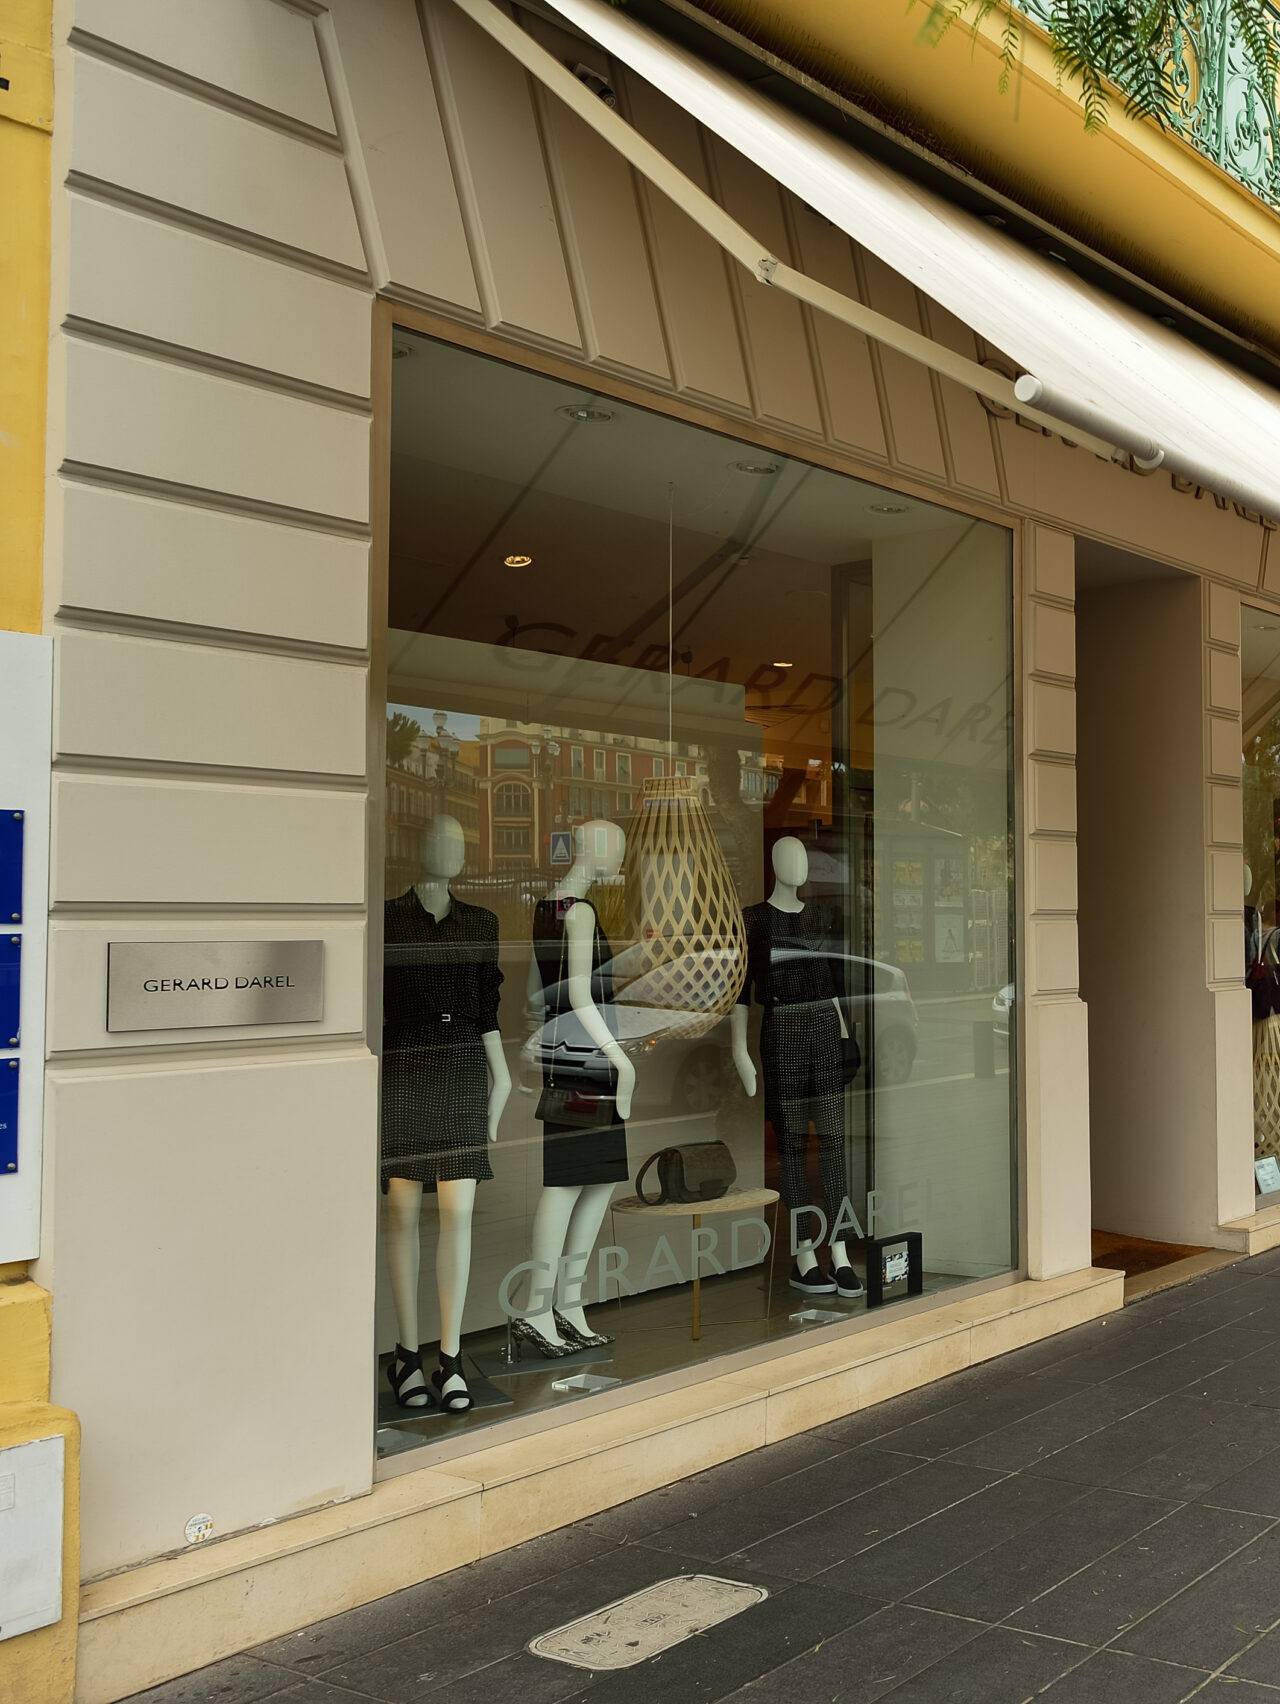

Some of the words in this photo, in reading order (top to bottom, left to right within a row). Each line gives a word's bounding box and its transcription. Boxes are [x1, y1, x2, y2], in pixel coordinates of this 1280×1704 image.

[143, 977, 229, 993] GERARD
[235, 975, 295, 989] DAREL
[498, 1217, 772, 1319] GERARD
